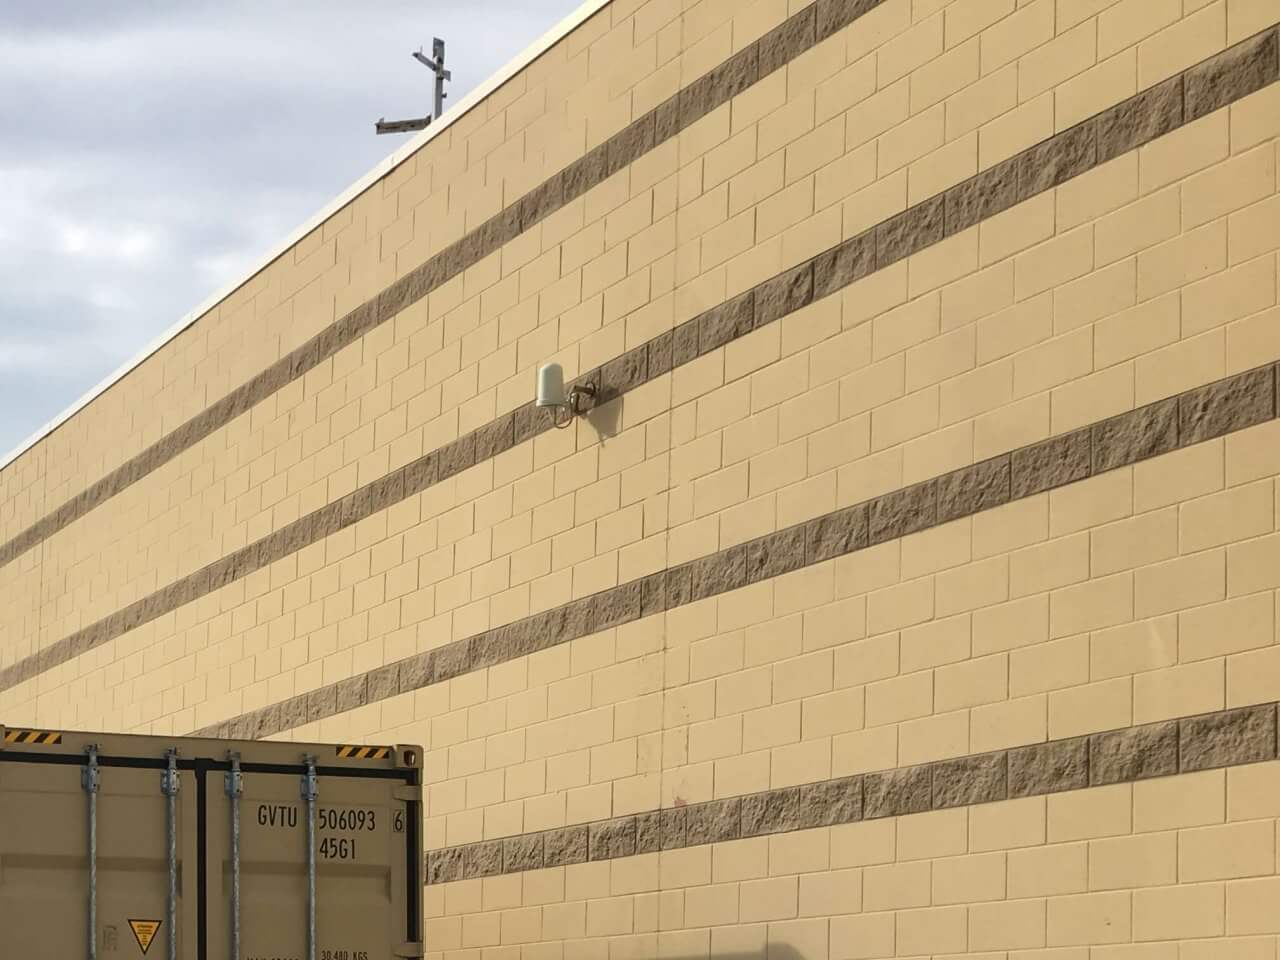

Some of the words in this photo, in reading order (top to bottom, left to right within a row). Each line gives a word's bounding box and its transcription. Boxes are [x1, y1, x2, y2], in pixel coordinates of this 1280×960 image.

[257, 804, 298, 828] GVTU
[319, 808, 376, 831] 506093
[319, 837, 356, 860] 45G1
